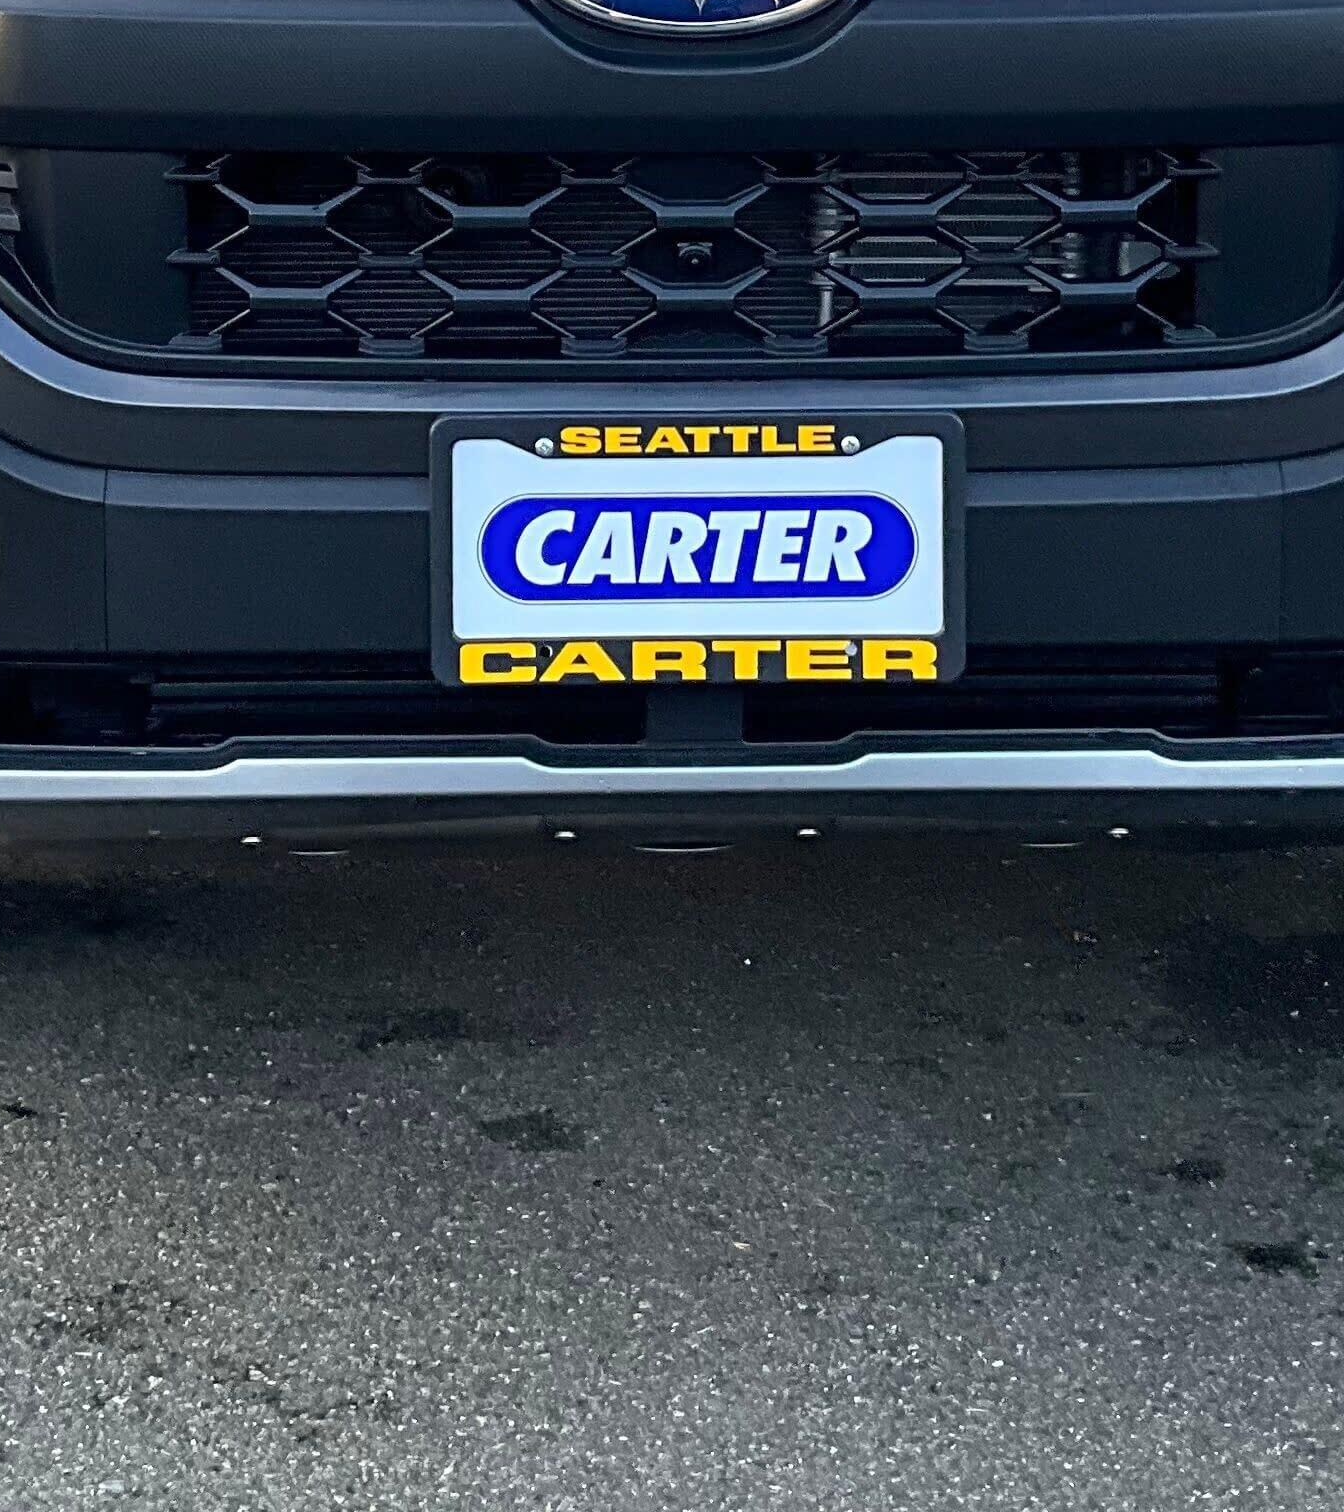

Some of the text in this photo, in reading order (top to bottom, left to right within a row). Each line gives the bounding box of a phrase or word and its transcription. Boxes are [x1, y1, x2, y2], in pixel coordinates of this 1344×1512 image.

[559, 425, 836, 455] SEATTLE
[515, 508, 874, 586] CARTER
[458, 639, 938, 684] CARTER
